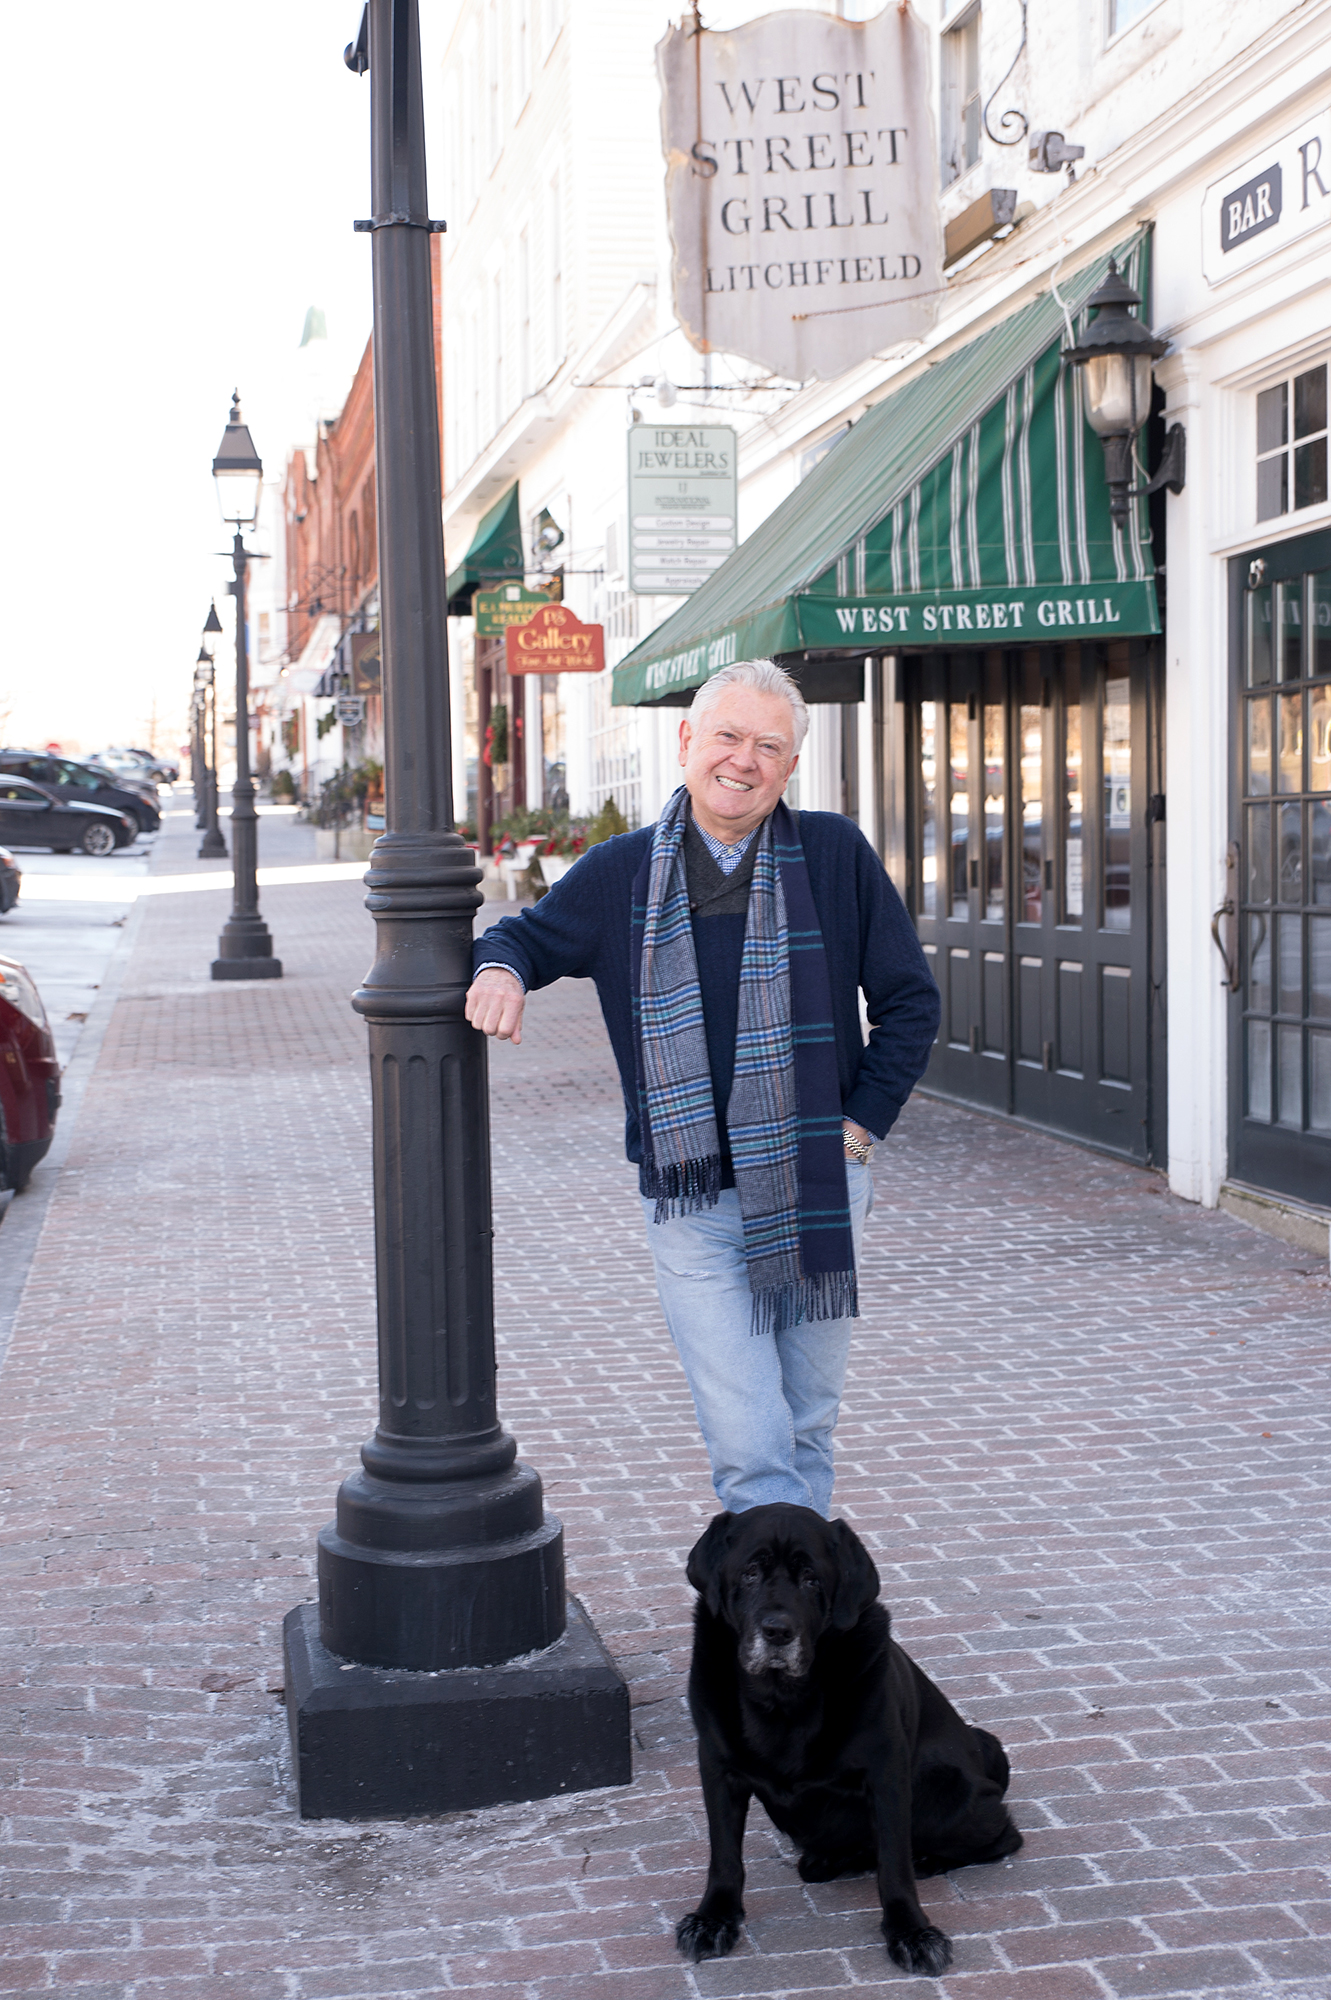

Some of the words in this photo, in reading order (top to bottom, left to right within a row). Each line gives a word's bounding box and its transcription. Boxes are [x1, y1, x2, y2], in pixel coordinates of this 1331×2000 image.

[715, 71, 875, 116] WEST
[690, 127, 908, 179] STREET
[720, 190, 889, 236] GRILL
[1228, 181, 1274, 241] BAR
[704, 254, 922, 293] LITCHFIELD
[655, 431, 710, 448] IDEAL
[638, 451, 728, 470] JEWELERS
[656, 519, 683, 528] Custom
[685, 519, 711, 530] Design
[657, 538, 684, 548] Jewelry
[687, 538, 711, 548] Repair
[684, 557, 708, 567] Repair
[834, 606, 911, 633] WEST
[922, 602, 1025, 631] STREET
[1037, 598, 1121, 627] GRILL
[517, 626, 594, 655] Gallery
